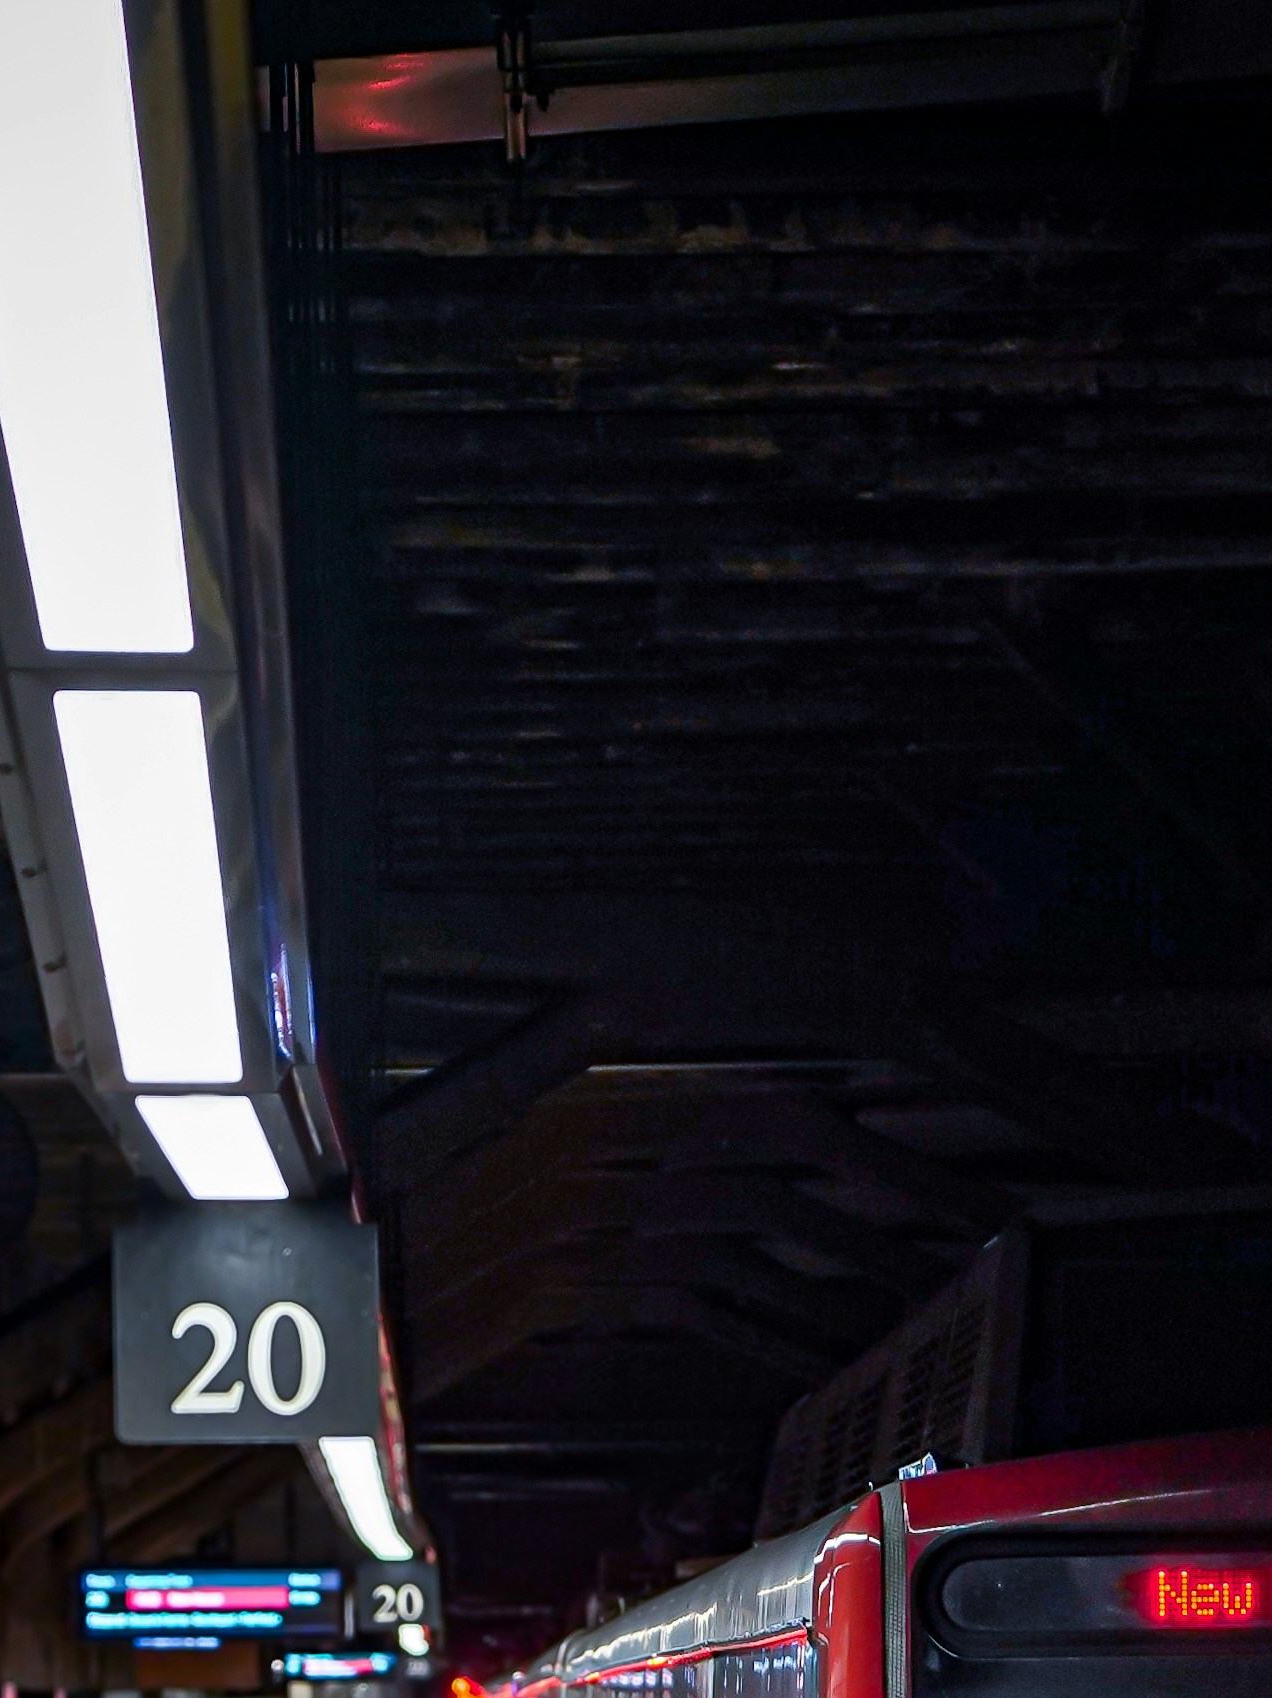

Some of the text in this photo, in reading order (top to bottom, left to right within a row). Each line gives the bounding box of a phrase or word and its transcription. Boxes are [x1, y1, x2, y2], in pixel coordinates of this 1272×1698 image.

[170, 1301, 326, 1416] 20
[372, 1583, 425, 1624] 20
[1158, 1570, 1253, 1617] New
